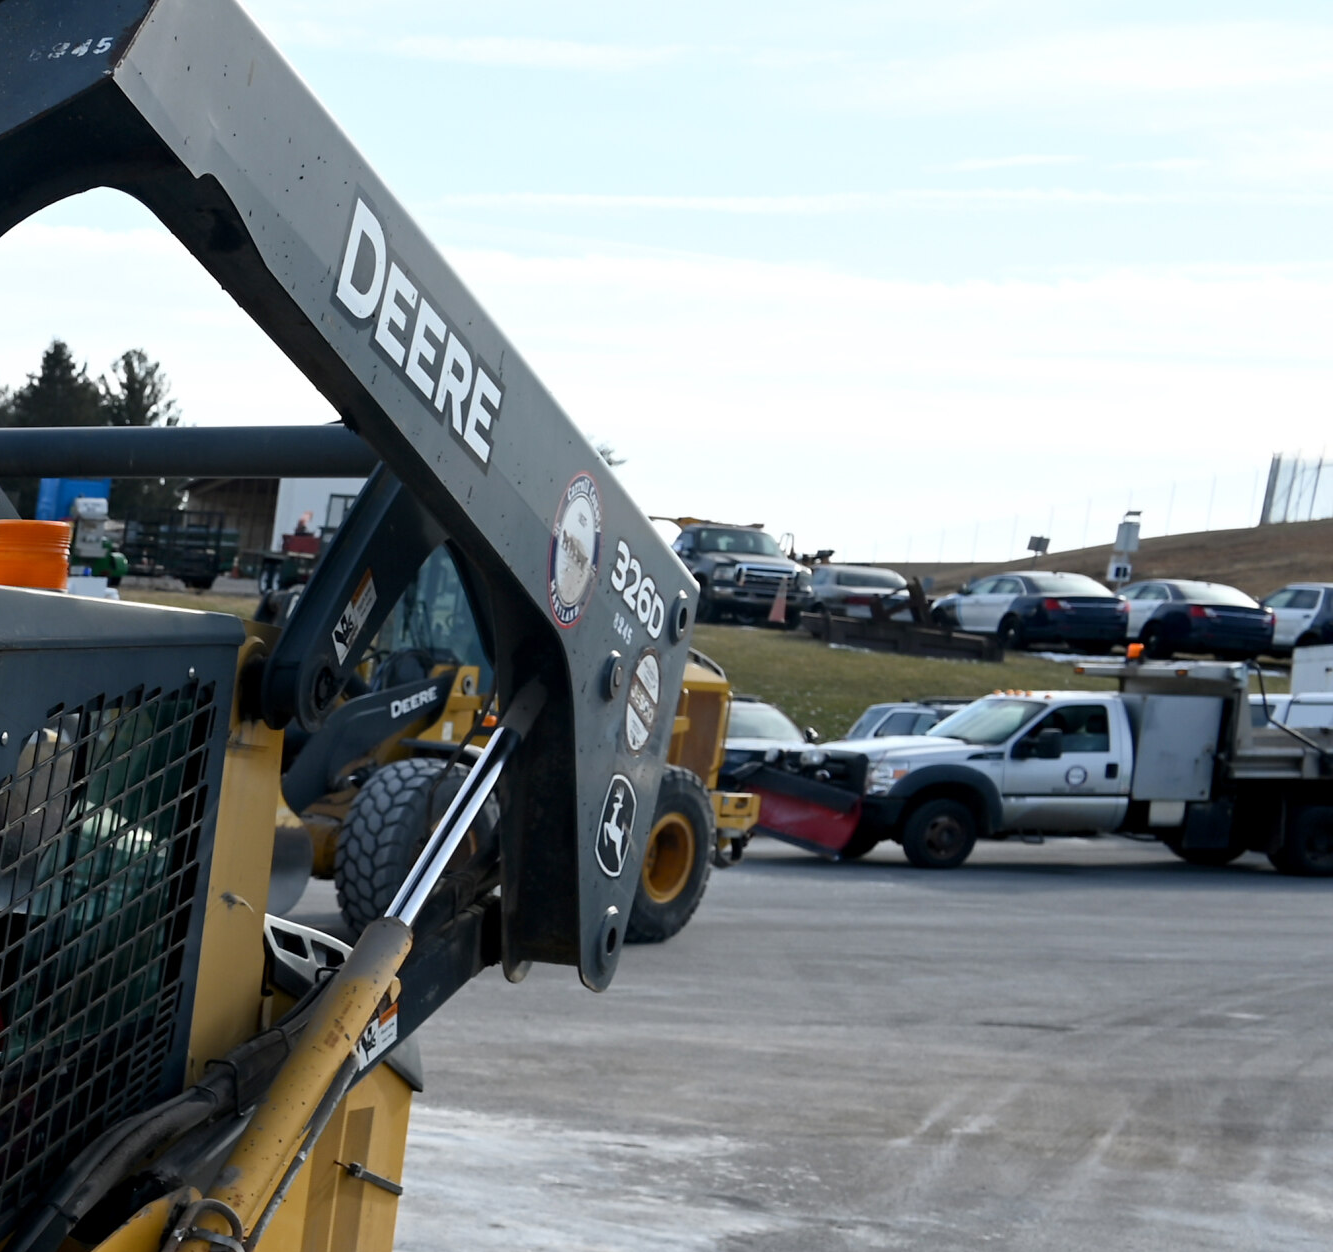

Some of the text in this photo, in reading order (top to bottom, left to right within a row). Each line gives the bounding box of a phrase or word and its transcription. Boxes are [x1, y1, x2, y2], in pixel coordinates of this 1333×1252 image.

[336, 197, 502, 464] DEERE
[611, 540, 665, 640] 326D
[390, 685, 438, 719] DEERE
